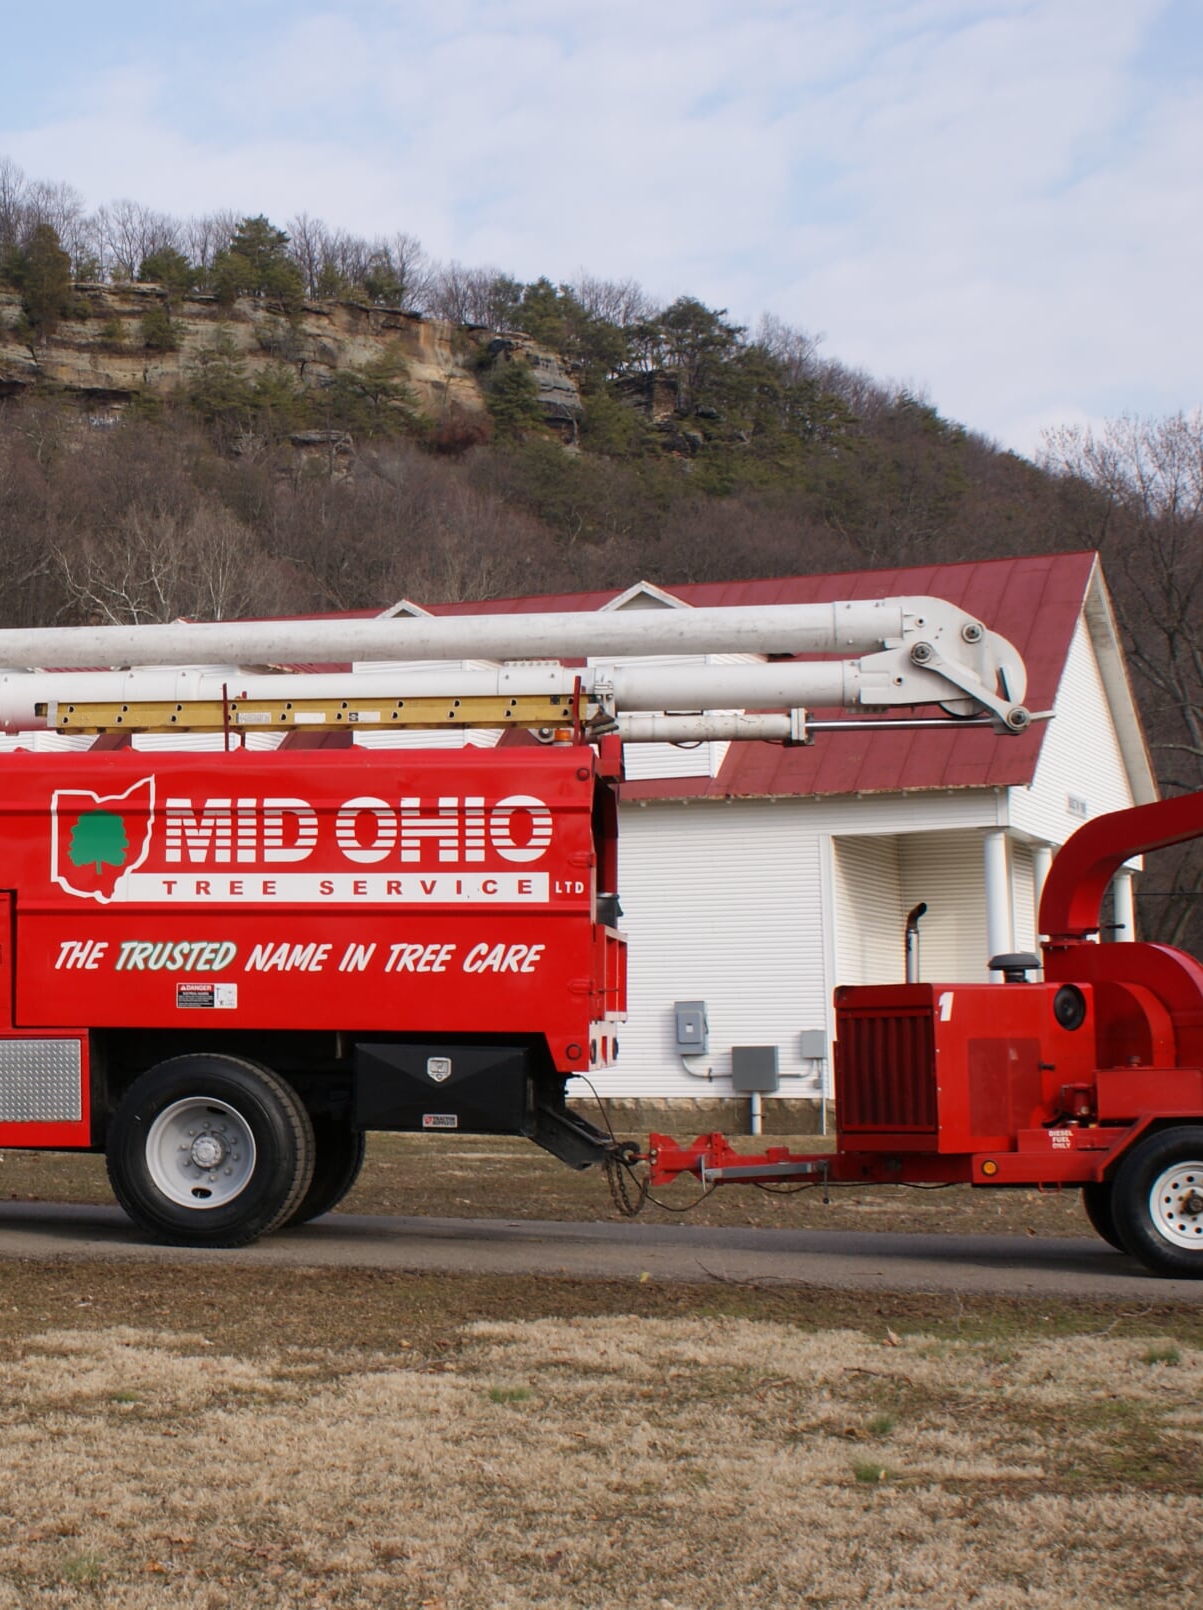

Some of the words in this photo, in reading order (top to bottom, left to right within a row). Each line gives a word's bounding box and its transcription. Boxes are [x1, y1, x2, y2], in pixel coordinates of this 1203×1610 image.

[165, 798, 319, 863] MID
[336, 795, 553, 863] OHIO
[162, 880, 277, 896] TREE
[319, 879, 533, 896] SERVICE
[555, 881, 584, 894] LTD
[55, 940, 108, 970] THE
[114, 940, 237, 971] TRUSTED
[244, 942, 333, 972] NAME
[338, 943, 377, 972] IN
[384, 943, 456, 973] TREE
[463, 943, 546, 973] CARE
[938, 991, 954, 1021] 1
